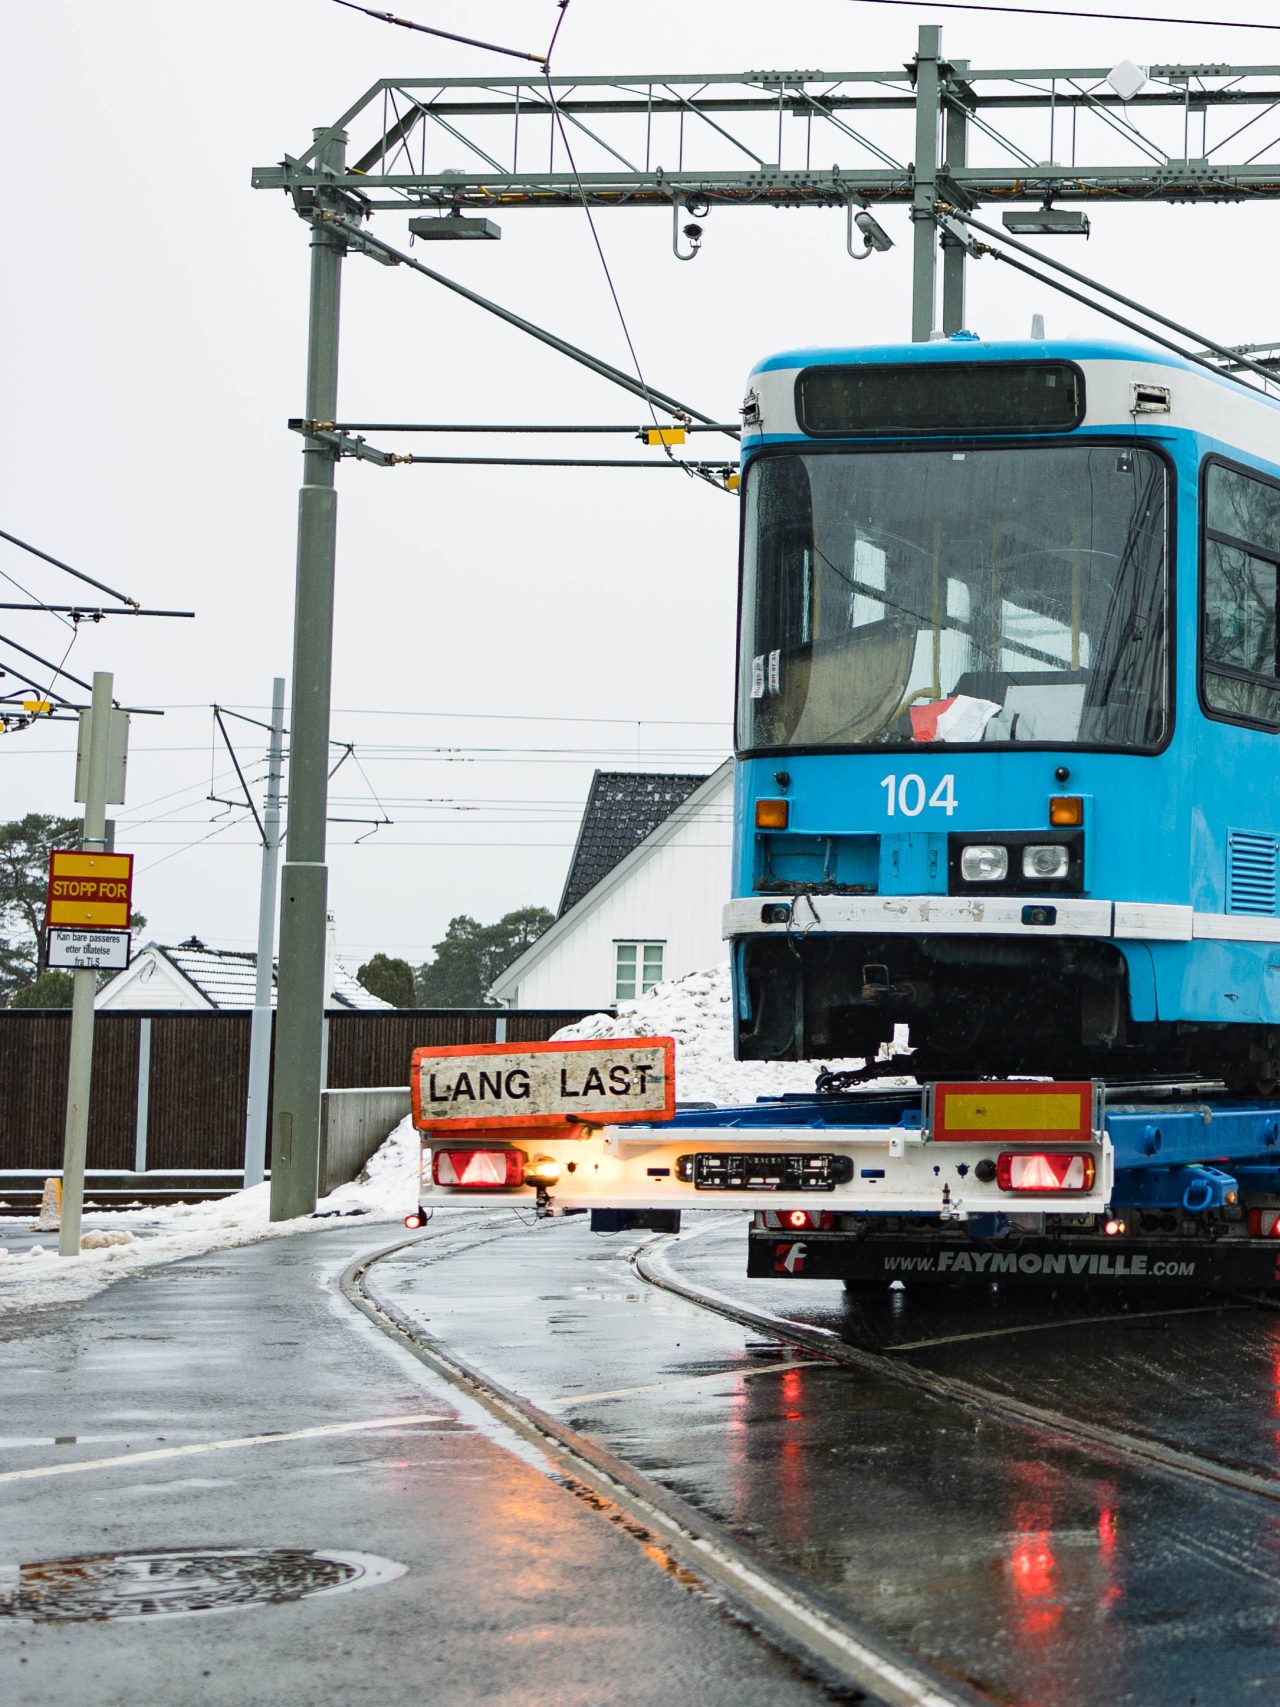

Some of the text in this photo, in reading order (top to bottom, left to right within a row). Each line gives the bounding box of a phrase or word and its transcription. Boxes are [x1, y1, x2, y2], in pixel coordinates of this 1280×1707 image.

[880, 774, 958, 816] 104
[53, 881, 127, 898] STOPP FOR
[56, 931, 121, 944] Kan bare passeres
[65, 943, 111, 955] etter tillatelse
[75, 957, 100, 967] fra TLS
[429, 1064, 653, 1102] LANG LAST
